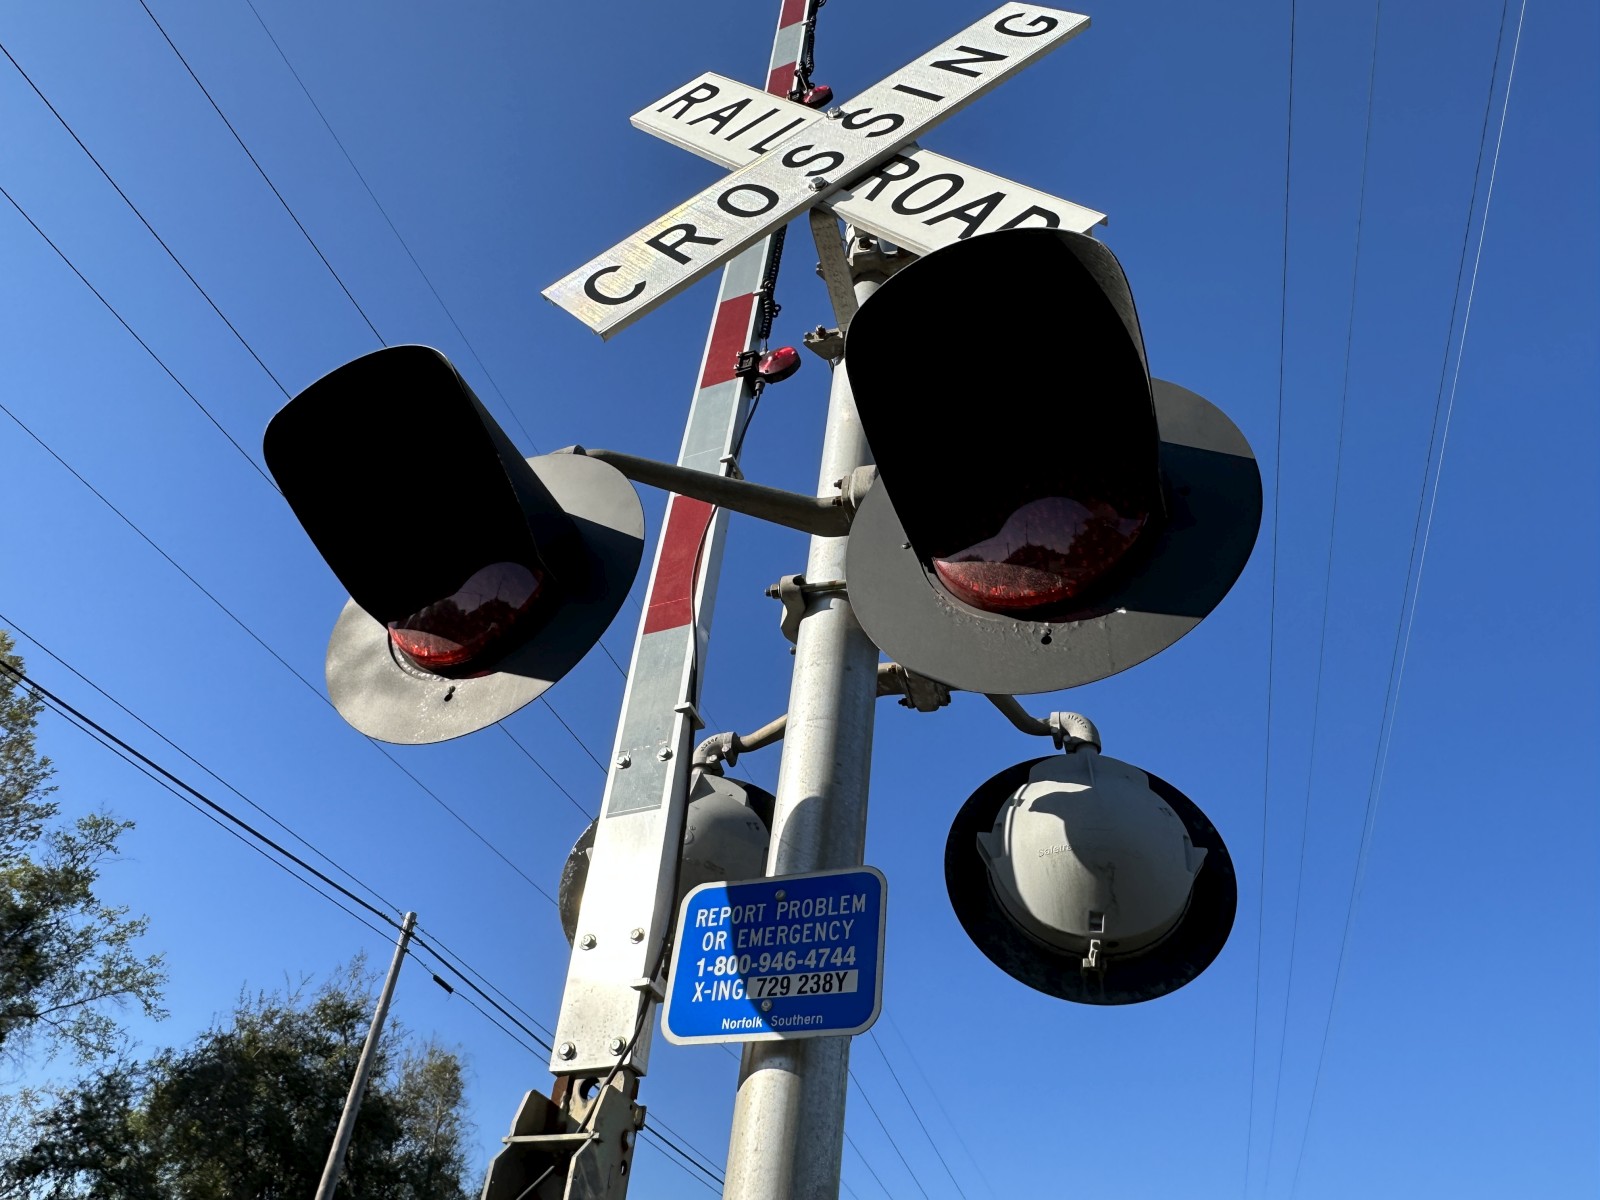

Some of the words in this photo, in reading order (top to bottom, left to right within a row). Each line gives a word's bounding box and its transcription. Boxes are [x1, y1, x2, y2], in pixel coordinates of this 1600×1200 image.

[656, 82, 806, 155] RAIL
[584, 12, 1058, 305] CROSSING
[695, 903, 767, 928] REPORT
[776, 893, 866, 921] PROBLEM
[702, 931, 727, 952] OR
[737, 919, 855, 949] EMERGENCY
[696, 946, 856, 977] 1-800-946-4744
[756, 975, 791, 998] 729
[796, 971, 849, 995] 238Y
[721, 1016, 763, 1030] Norfolk
[770, 1014, 823, 1027] Southern
